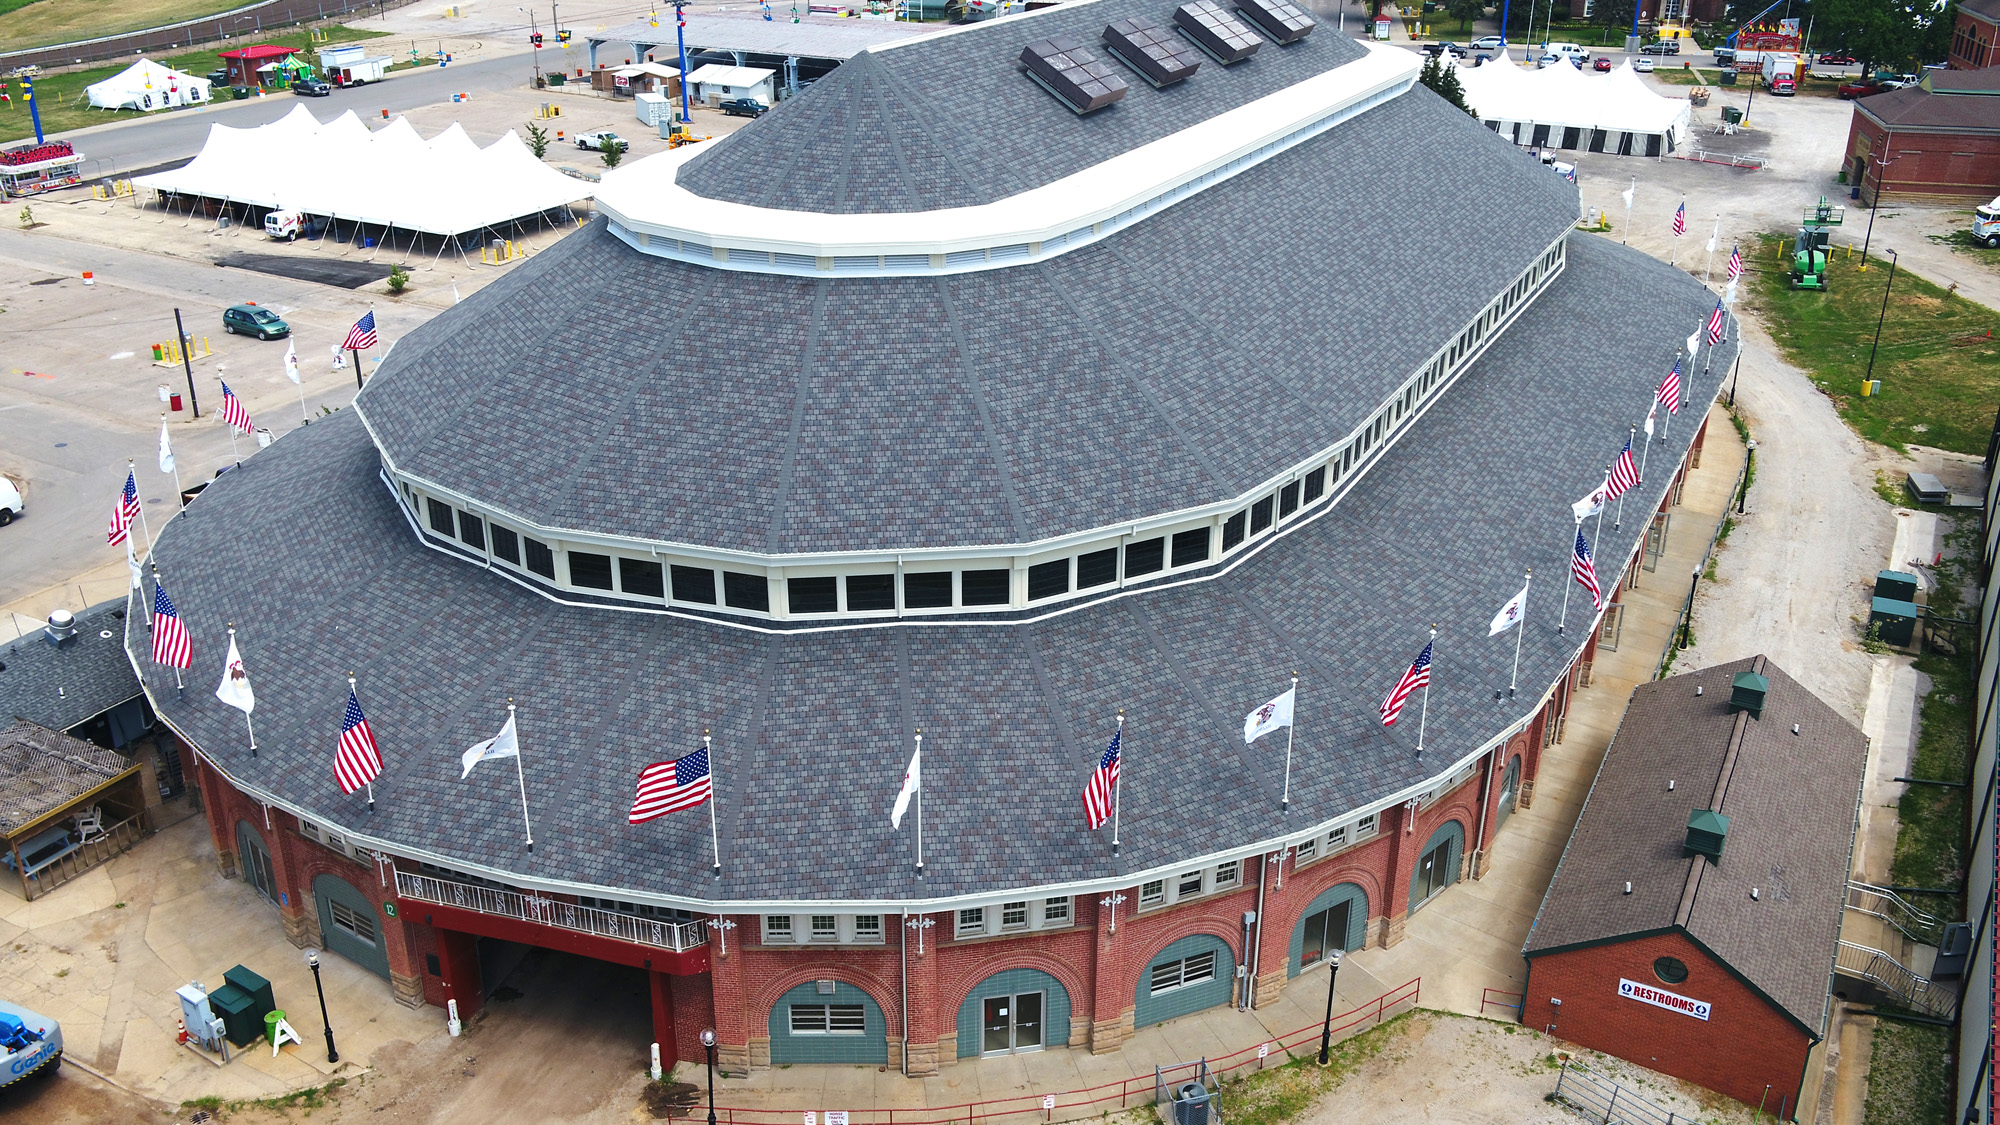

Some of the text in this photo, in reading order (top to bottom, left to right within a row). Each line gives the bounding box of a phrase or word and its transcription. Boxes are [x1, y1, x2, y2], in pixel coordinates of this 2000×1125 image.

[386, 904, 395, 916] 12
[1633, 985, 1695, 1013] RESTROOMS
[11, 1042, 56, 1075] Genie
